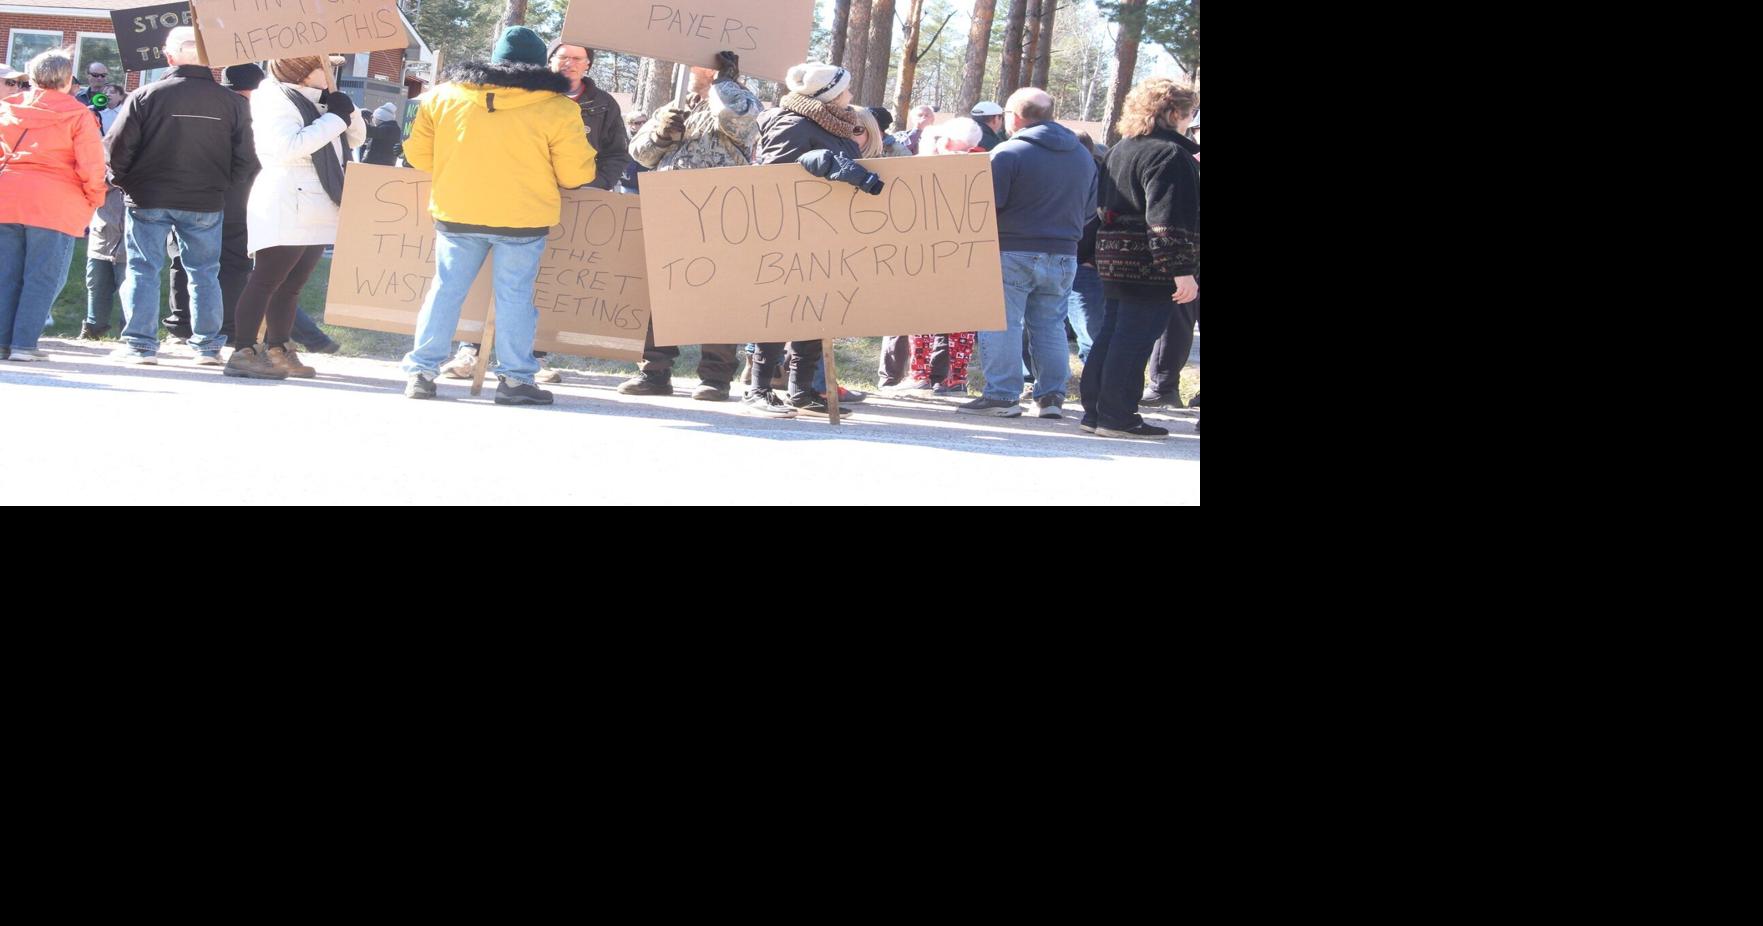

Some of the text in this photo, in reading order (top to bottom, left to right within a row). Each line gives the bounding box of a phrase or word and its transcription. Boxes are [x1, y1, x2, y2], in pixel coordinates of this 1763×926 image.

[134, 11, 191, 33] STOP
[234, 9, 397, 59] AFFORD THIS
[647, 5, 759, 51] PAYERS
[374, 180, 432, 227] ST
[680, 169, 990, 245] YOUR GOING
[550, 247, 603, 264] THE
[662, 239, 996, 291] TO BANKRUPT
[355, 267, 433, 303] WAST
[535, 266, 644, 295] ECRET
[534, 288, 644, 330] EETINGS
[760, 287, 860, 329] TINY
